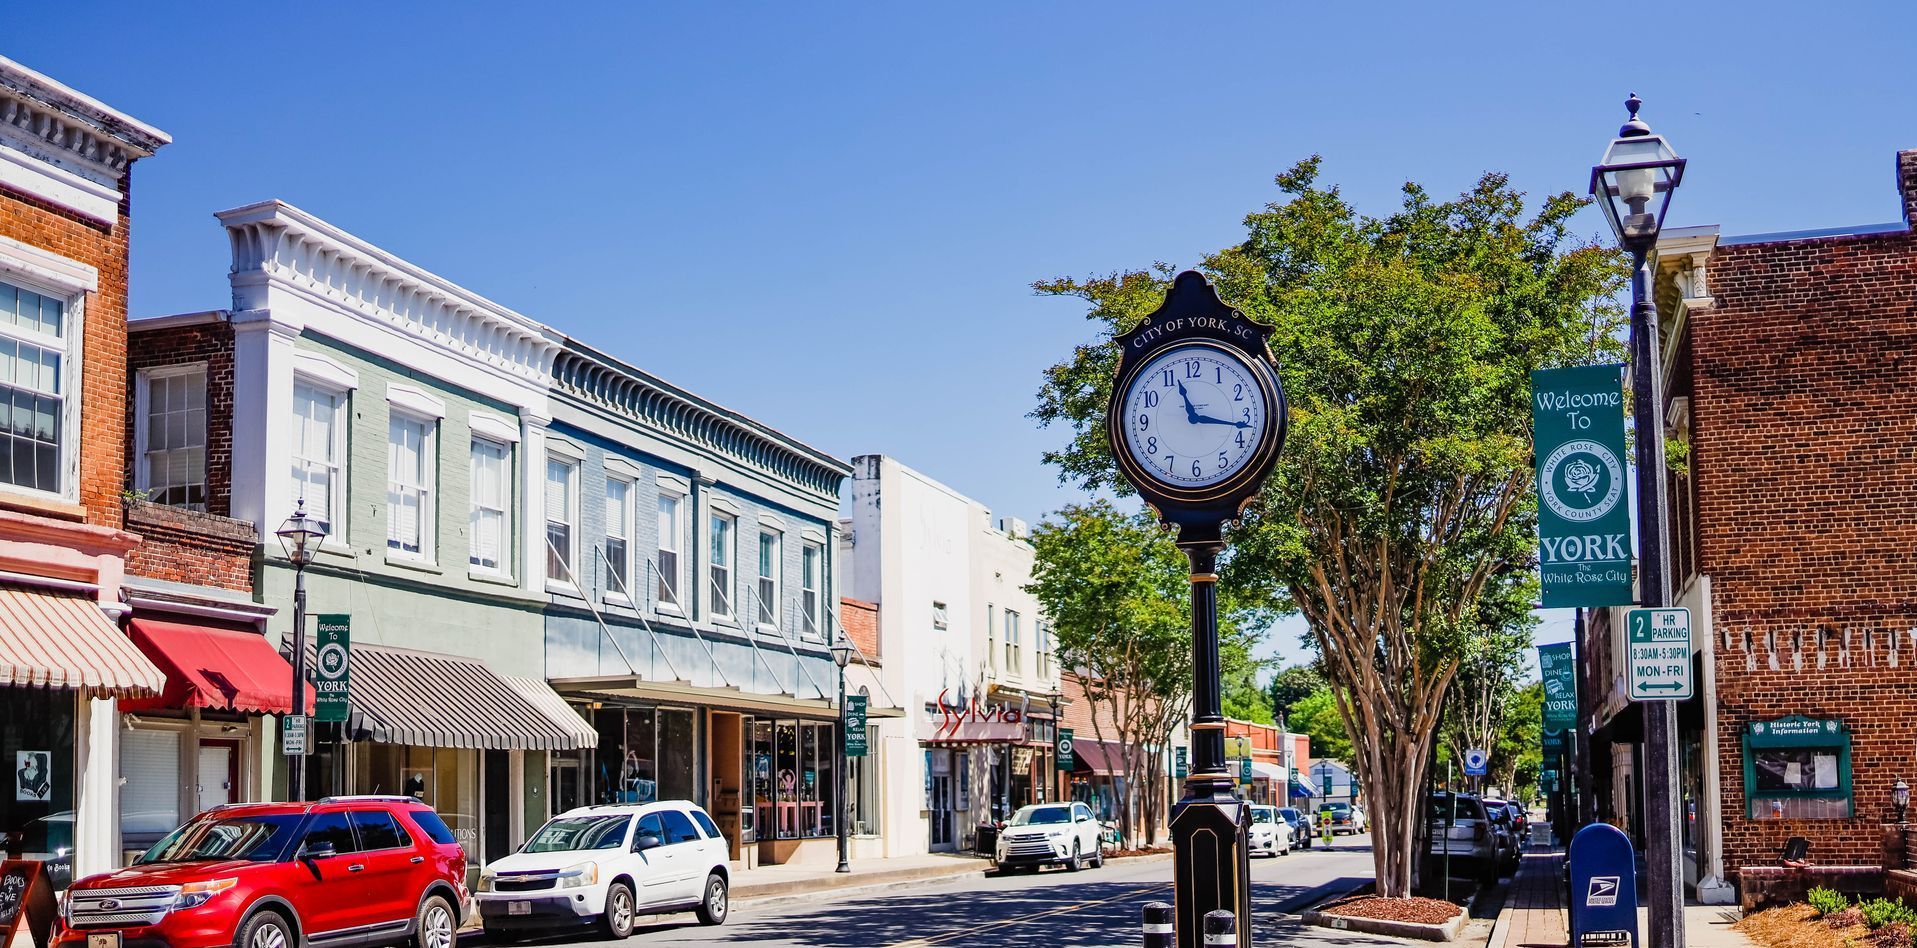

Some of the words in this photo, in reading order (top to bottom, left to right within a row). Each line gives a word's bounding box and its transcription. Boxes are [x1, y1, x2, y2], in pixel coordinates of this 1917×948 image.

[1133, 324, 1162, 348] CITY
[1166, 318, 1184, 332] OF
[1188, 316, 1230, 333] YORK,
[1234, 325, 1252, 340] SC
[1163, 369, 1175, 387] 11
[1185, 361, 1201, 379] 12
[1215, 367, 1222, 384] 1
[1144, 390, 1159, 408] 10
[1233, 384, 1242, 401] 2
[1536, 390, 1621, 411] Welcome
[1140, 414, 1149, 432] 9
[1242, 407, 1251, 424] 3
[1566, 411, 1591, 430] To
[1147, 437, 1157, 454] 8
[1234, 431, 1245, 449] 4
[1164, 455, 1175, 474] 7
[1218, 451, 1228, 469] 5
[1545, 448, 1567, 473] WHITE
[1570, 443, 1594, 452] ROSE
[1601, 452, 1618, 470] CITY
[1192, 460, 1201, 477] 6
[1545, 490, 1563, 512] YORK
[1564, 507, 1603, 519] COUNTY
[1604, 487, 1619, 507] SEAT
[1541, 533, 1628, 563] YORK
[1578, 563, 1591, 571] The
[1543, 572, 1574, 584] White
[1575, 571, 1604, 583] Rose
[1605, 568, 1628, 584] City
[318, 623, 349, 632] Welcome
[1636, 616, 1645, 638] 2
[1662, 614, 1676, 626] HR
[328, 632, 338, 640] To
[1652, 627, 1688, 639] PARKING
[1551, 652, 1571, 661] SHOP
[1544, 668, 1562, 677] DINE
[317, 681, 348, 691] YORK
[1554, 691, 1575, 699] RELAX
[935, 688, 1022, 736] Sylvia
[1546, 700, 1576, 711] YORK
[1770, 721, 1801, 729] Historic
